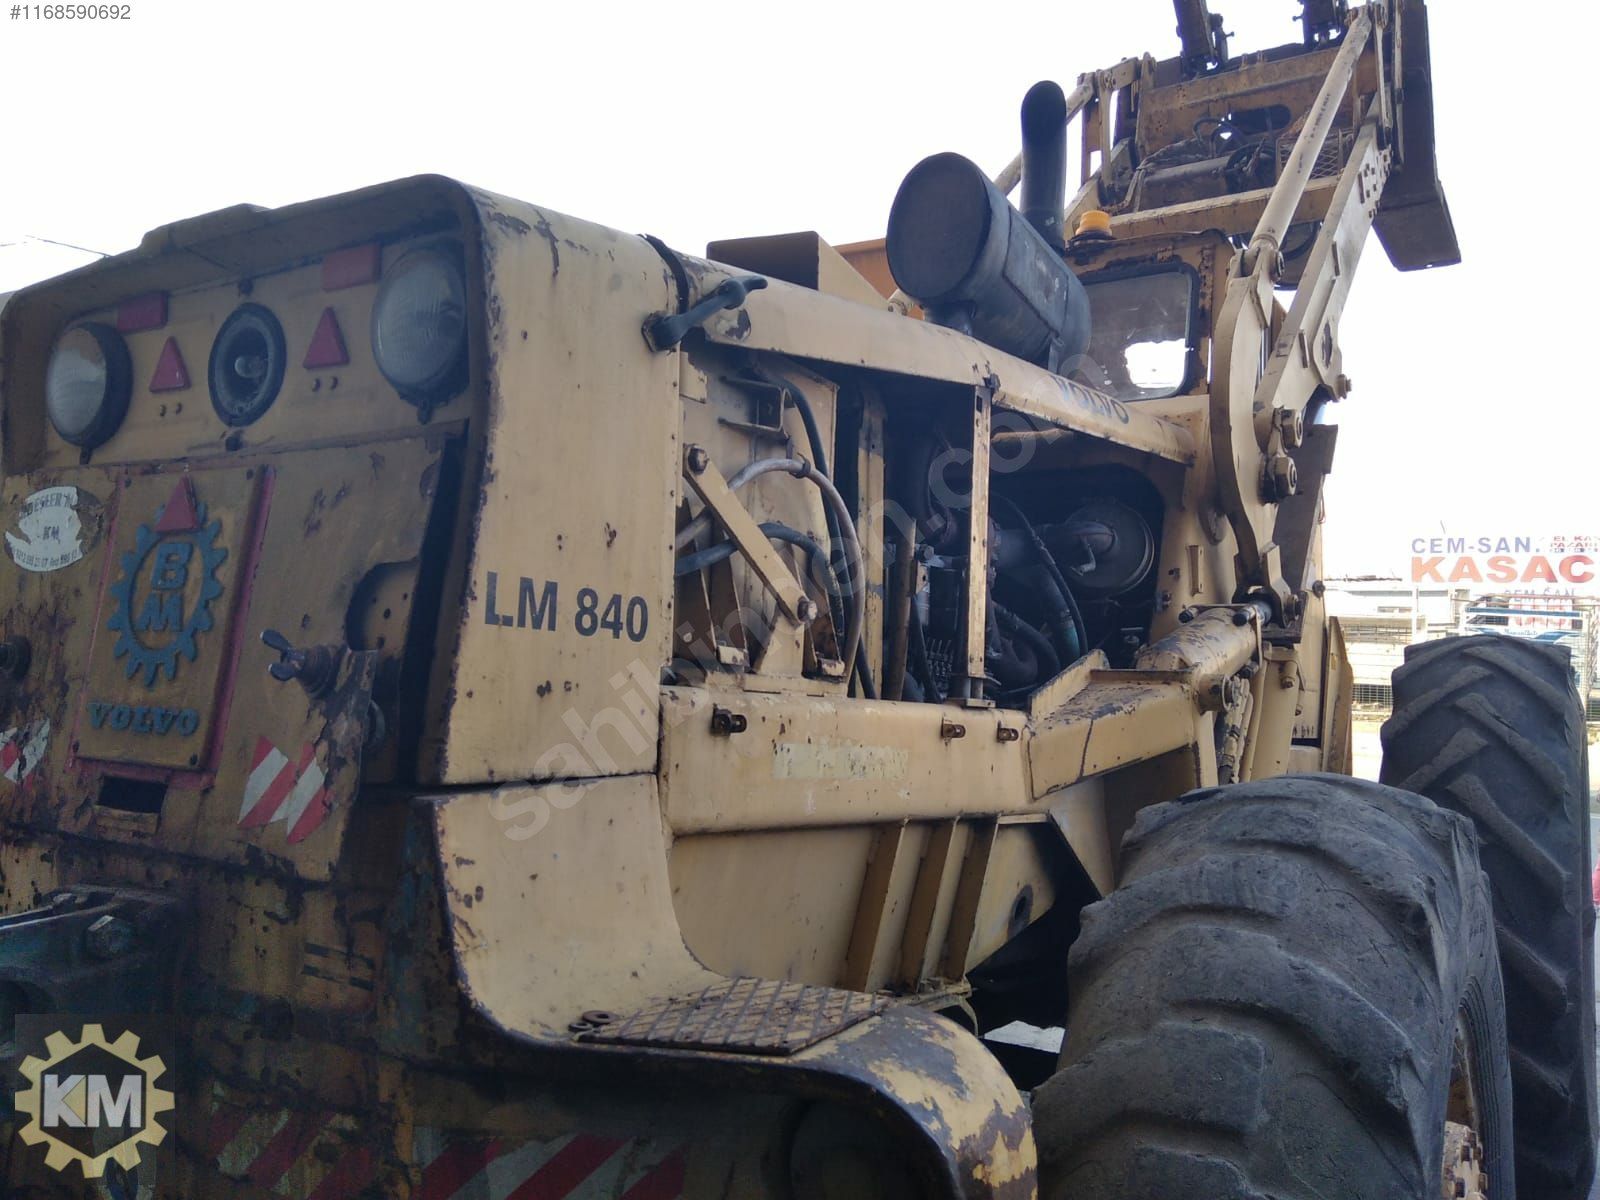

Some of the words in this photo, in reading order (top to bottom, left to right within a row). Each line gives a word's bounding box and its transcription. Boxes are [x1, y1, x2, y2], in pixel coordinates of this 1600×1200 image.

[485, 571, 559, 632] LM
[574, 587, 649, 642] 840
[87, 702, 199, 737] VOLVO
